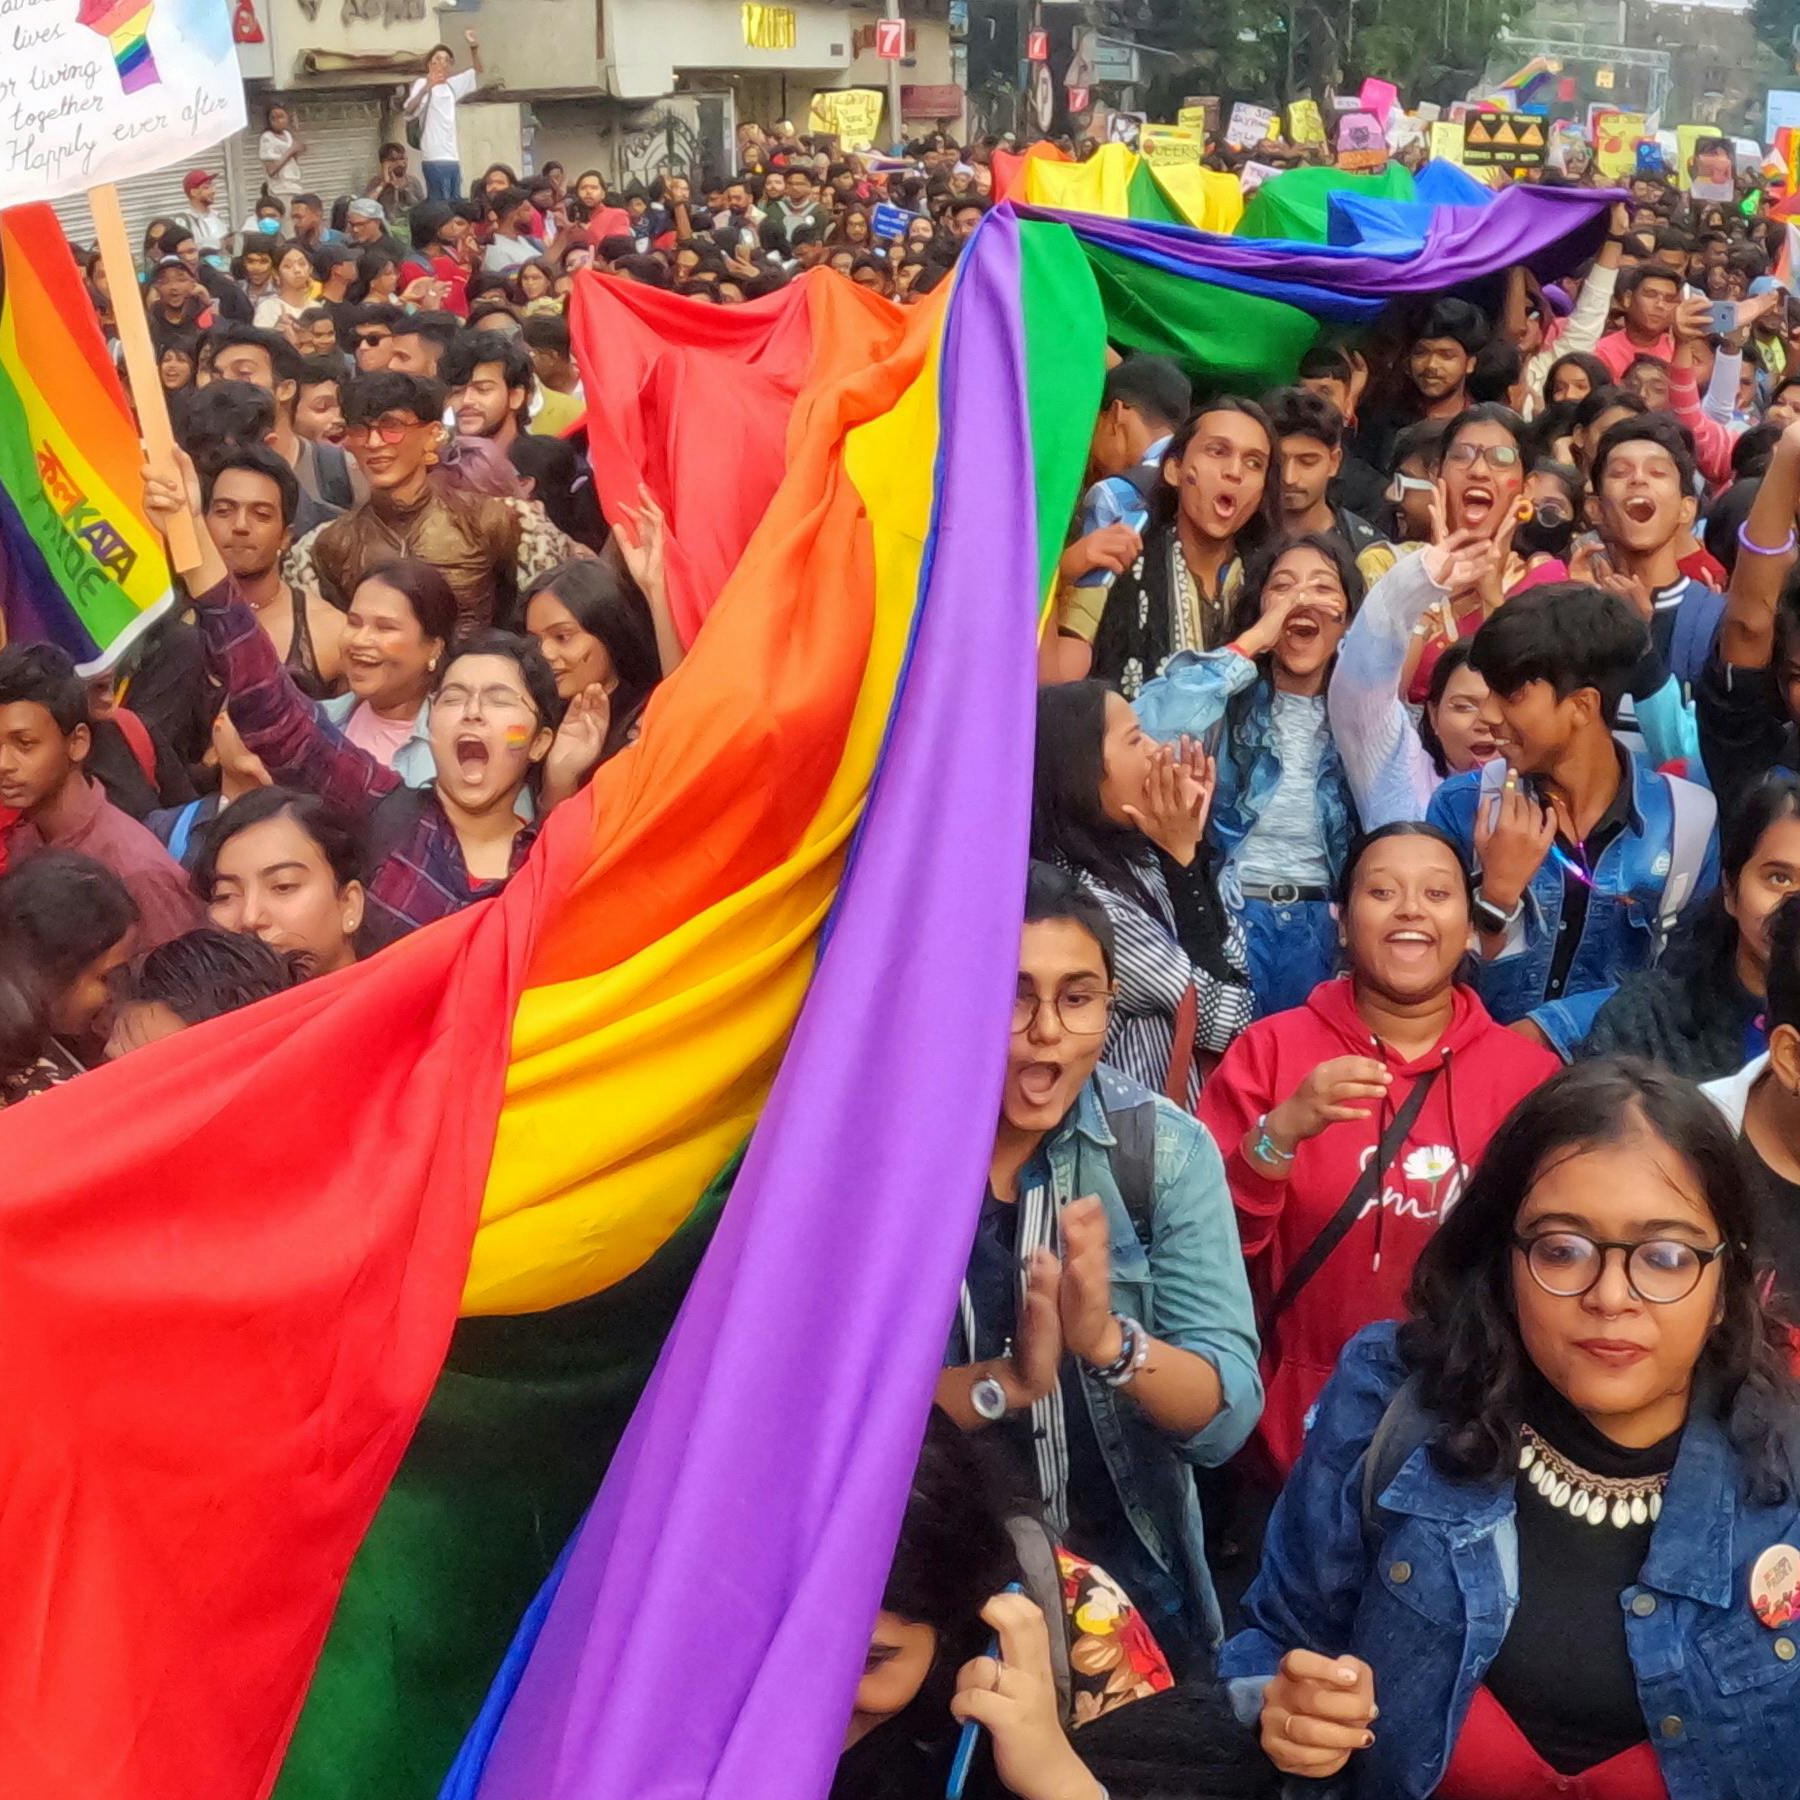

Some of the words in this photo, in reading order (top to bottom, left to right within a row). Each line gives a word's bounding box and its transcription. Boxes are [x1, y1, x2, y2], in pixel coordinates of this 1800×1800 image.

[11, 22, 65, 50] lives
[880, 24, 900, 53] 7
[29, 59, 102, 92] living
[9, 94, 104, 132] together
[5, 122, 98, 183] Happily
[111, 113, 170, 142] ever
[181, 85, 230, 137] after
